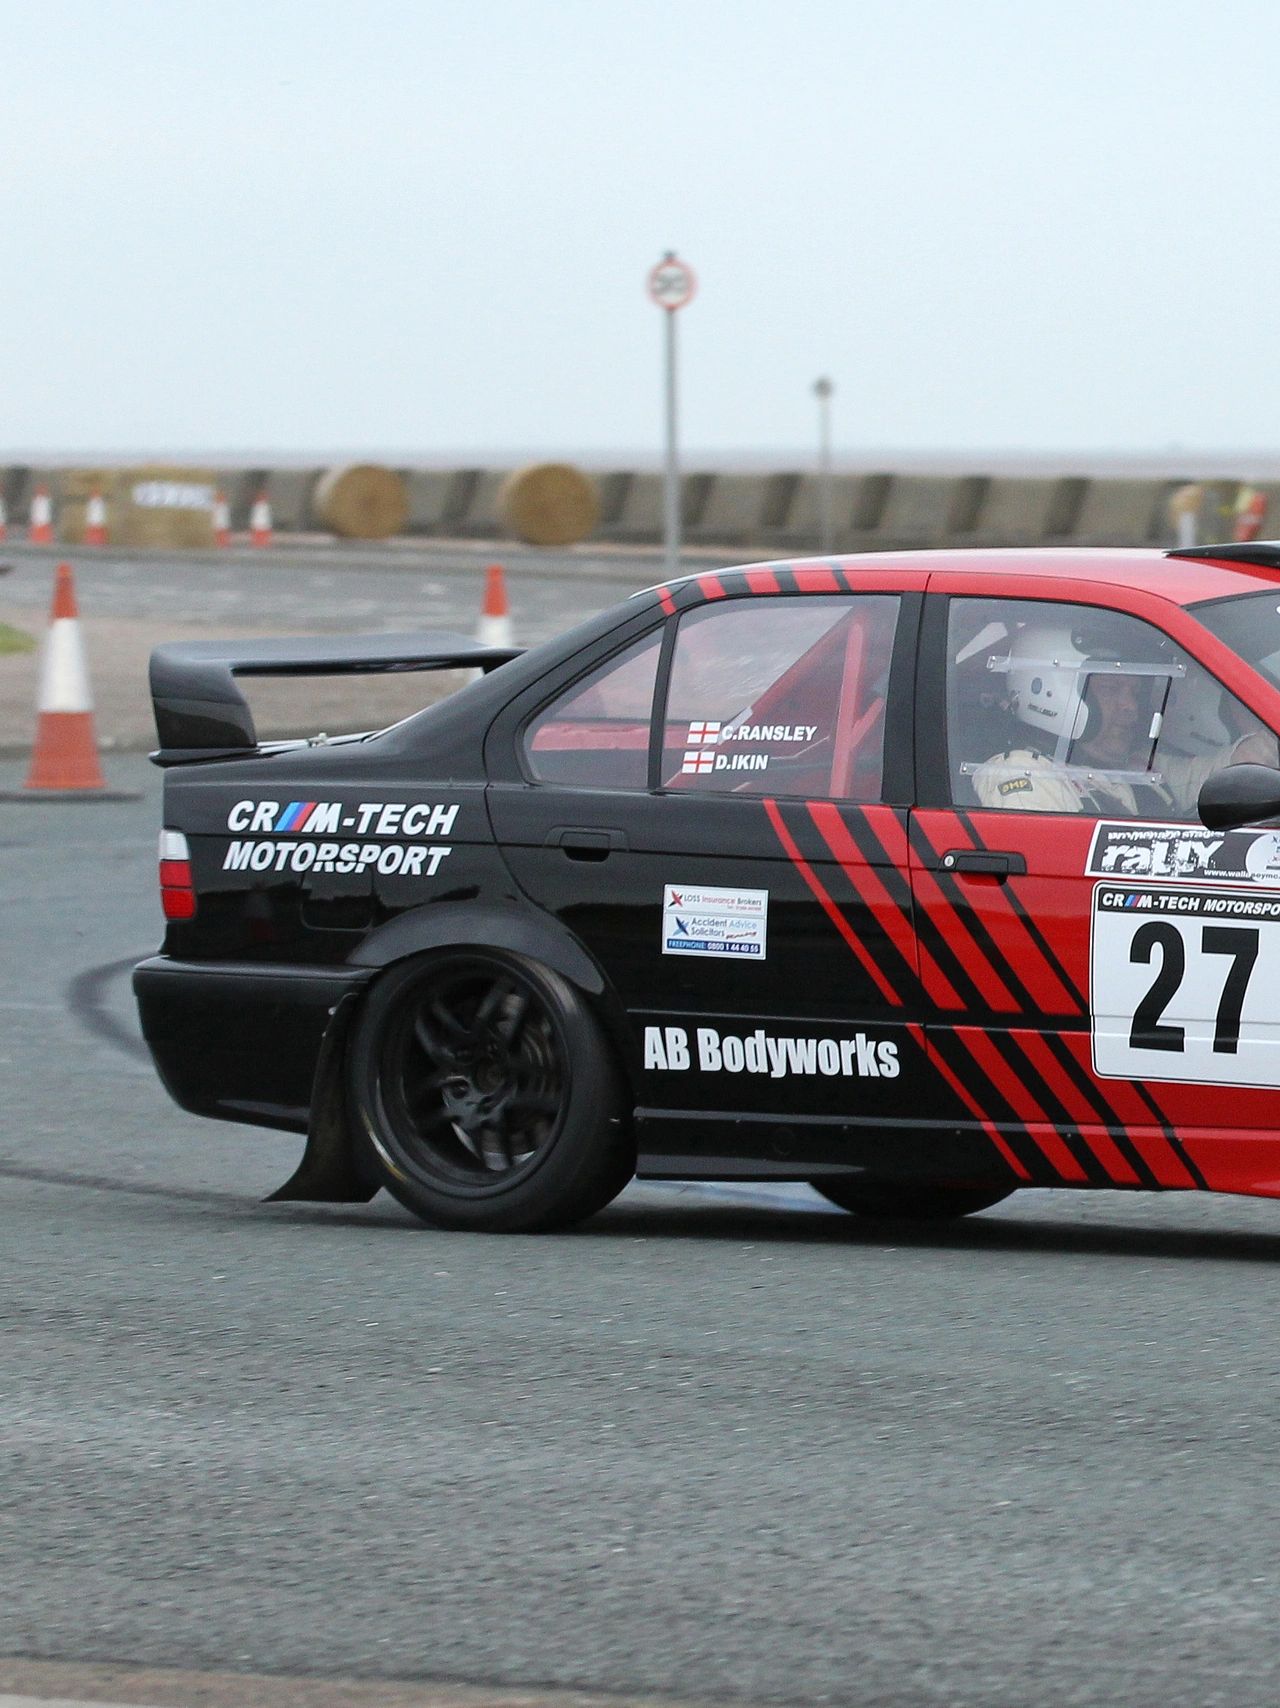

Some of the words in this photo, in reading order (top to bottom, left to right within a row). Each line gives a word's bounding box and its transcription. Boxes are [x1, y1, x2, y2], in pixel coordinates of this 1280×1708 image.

[721, 725, 817, 741] C.RANSLEY
[715, 754, 769, 770] D.IKIN
[222, 840, 452, 876] MOTORSPORT
[702, 895, 736, 905] Insurance
[737, 897, 762, 906] Brokers
[691, 917, 728, 928] Accident
[729, 920, 757, 930] Advice
[691, 927, 725, 937] Solicitors
[1129, 921, 1260, 1055] 27
[644, 1026, 691, 1071] AB
[696, 1027, 900, 1079] Bodyworks
